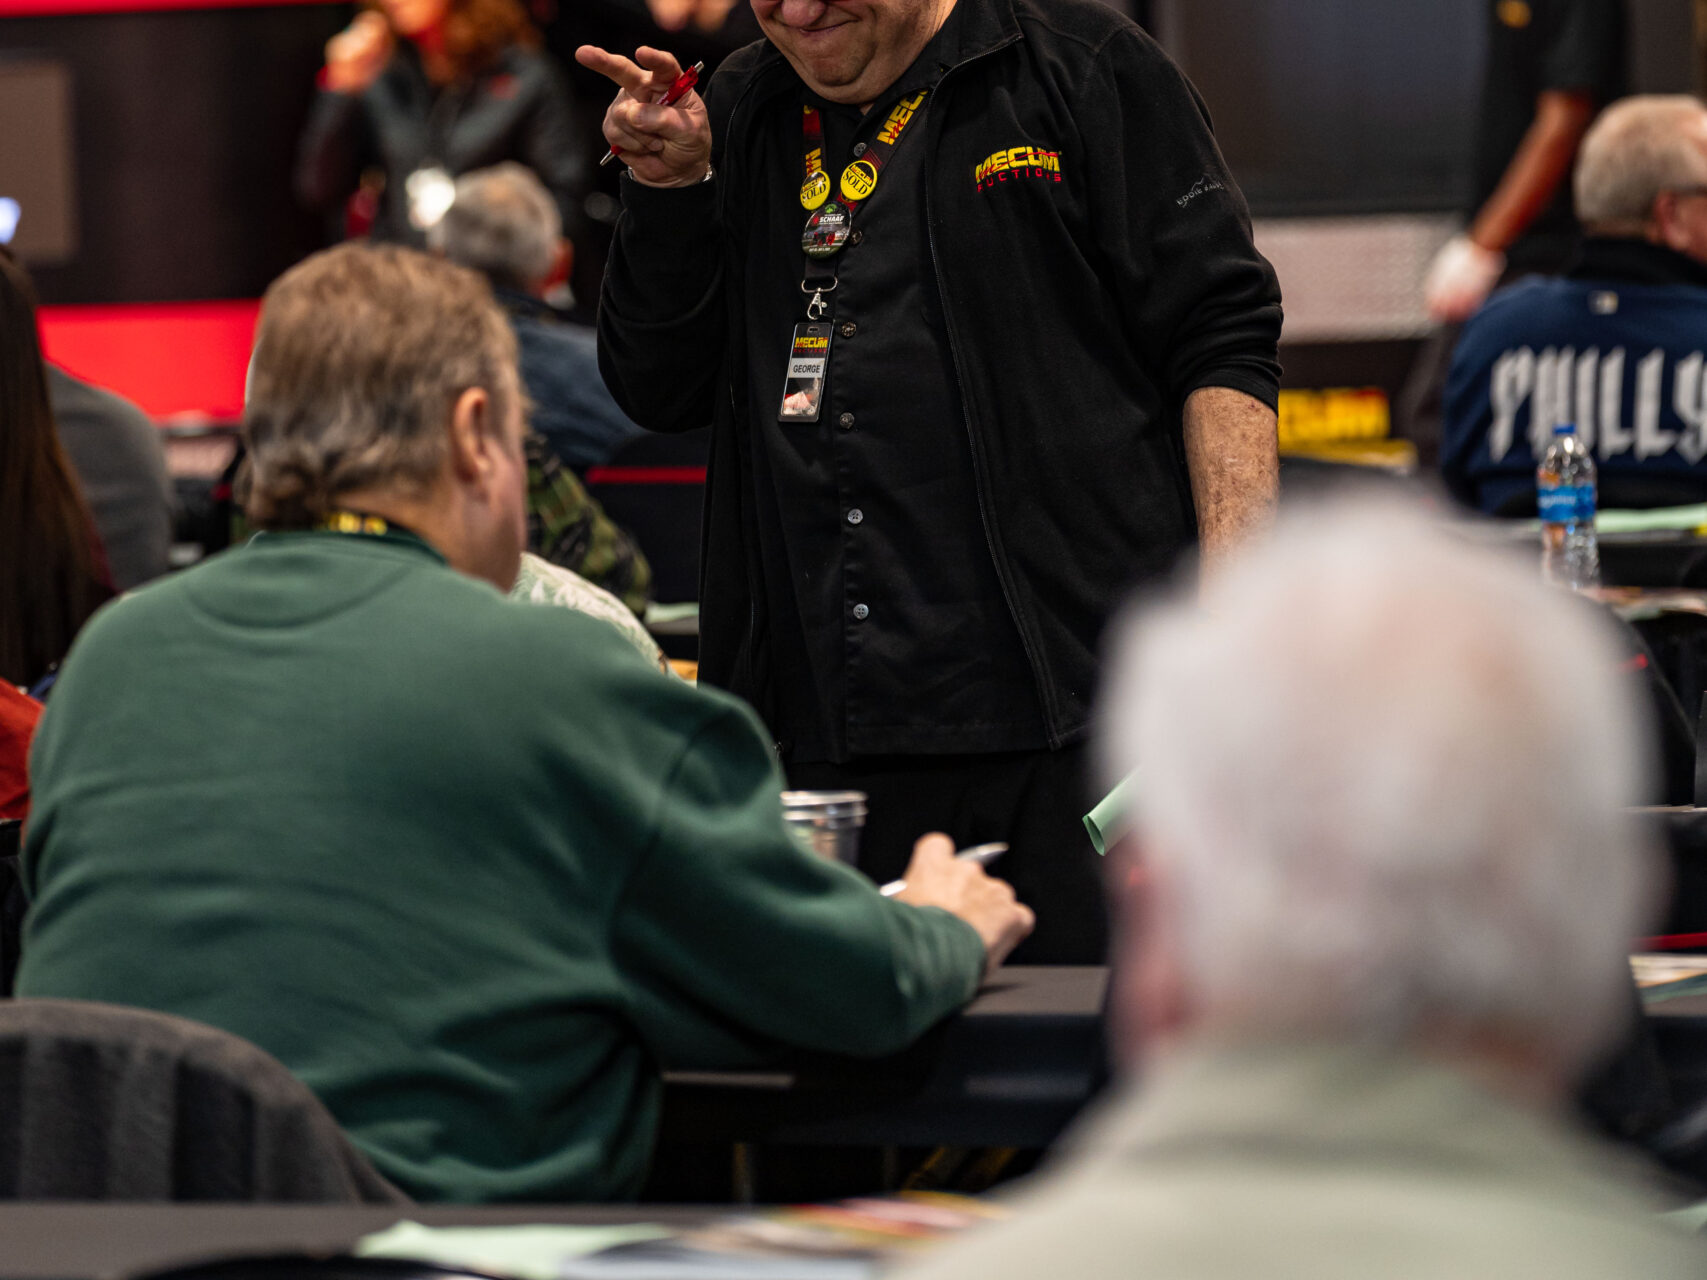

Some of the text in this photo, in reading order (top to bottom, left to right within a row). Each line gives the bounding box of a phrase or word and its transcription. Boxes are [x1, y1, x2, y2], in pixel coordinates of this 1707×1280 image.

[876, 90, 928, 145] MEC
[975, 146, 1061, 185] MECUM
[801, 183, 827, 204] SOLD
[842, 170, 869, 196] SOLD
[794, 336, 829, 348] MECUM
[792, 364, 821, 374] GEORGE
